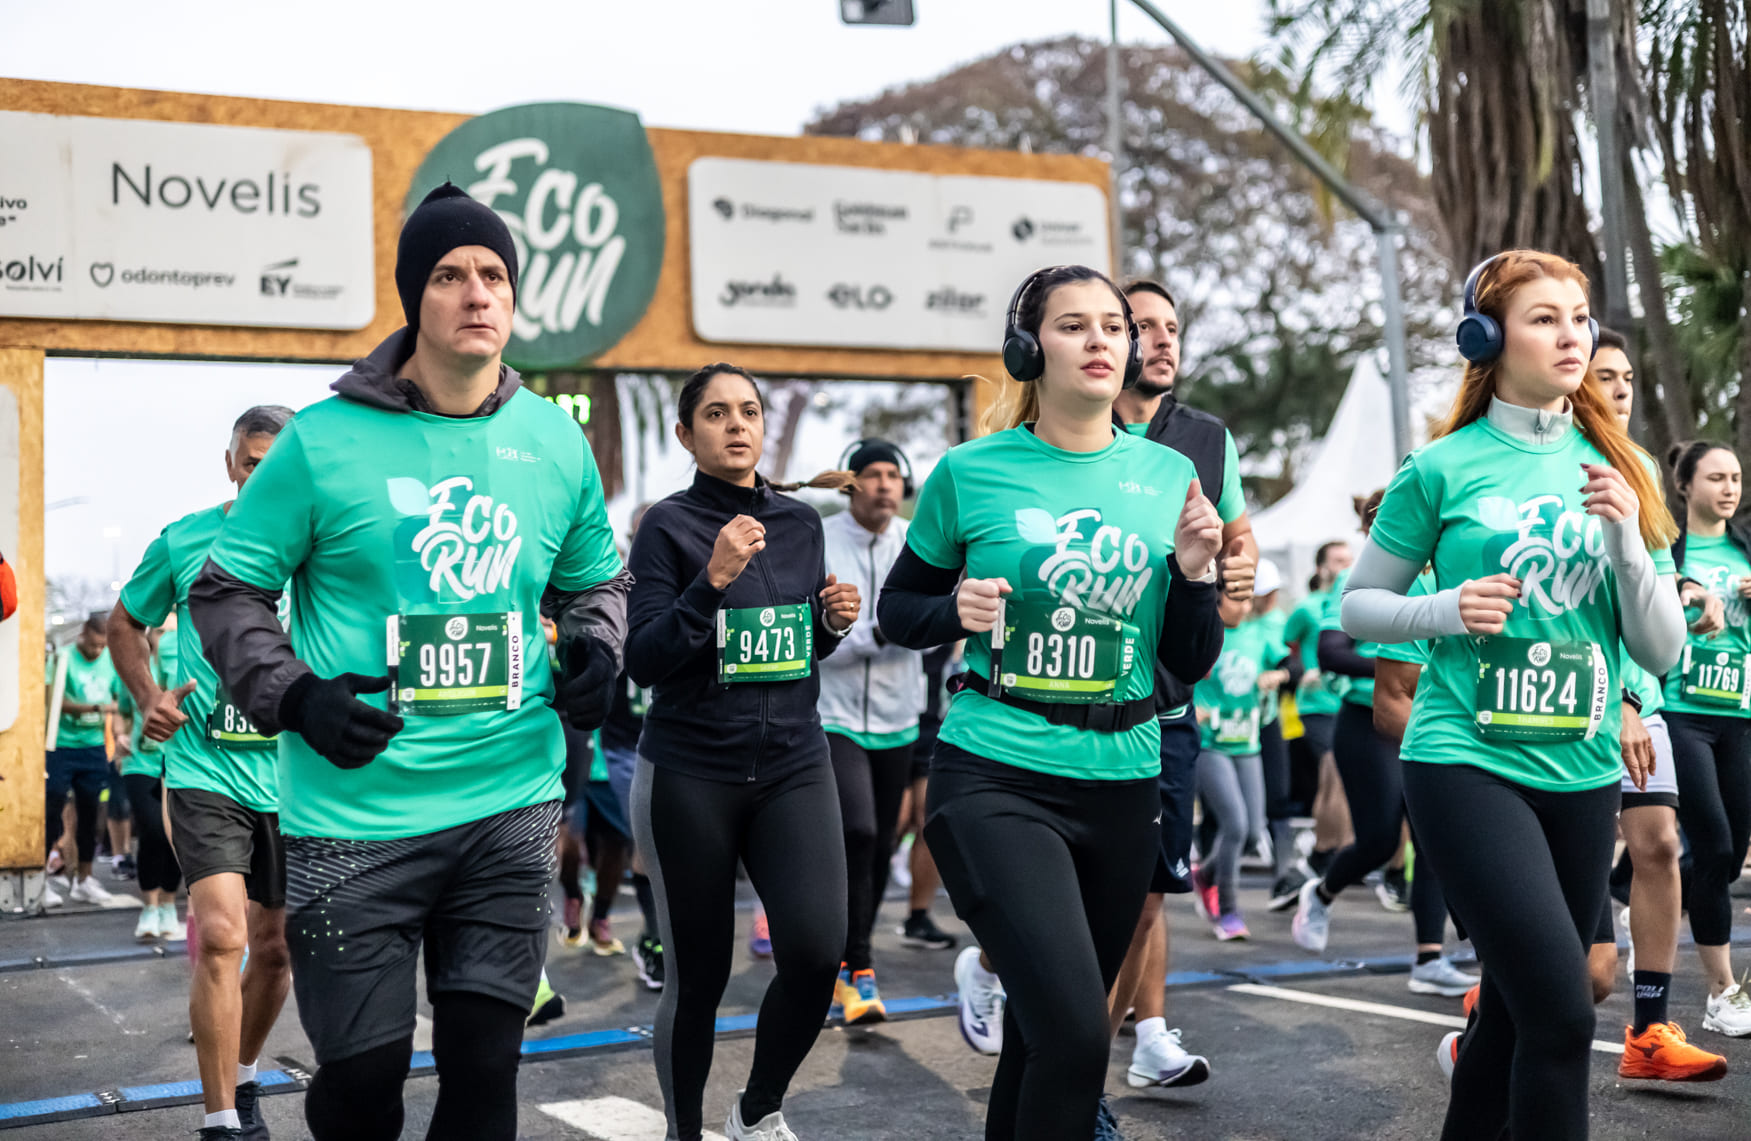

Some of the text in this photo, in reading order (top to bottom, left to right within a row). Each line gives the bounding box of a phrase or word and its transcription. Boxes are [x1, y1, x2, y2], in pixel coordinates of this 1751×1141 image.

[111, 161, 322, 219] Novelis
[468, 137, 619, 251] Eco
[120, 264, 236, 289] odontoprev
[259, 275, 292, 298] EY
[411, 476, 518, 553] Eco
[1500, 494, 1606, 568] Eco
[420, 532, 522, 600] Run
[1038, 508, 1149, 582] Eco
[1047, 560, 1153, 616] Run
[1510, 547, 1608, 616] Run
[739, 626, 796, 664] 9473
[1085, 617, 1110, 626] Novelis
[419, 642, 492, 687] 9957
[511, 634, 520, 688] BRANCO
[1026, 632, 1097, 679] 8310
[1121, 637, 1135, 677] VERDE
[1559, 652, 1583, 661] Novelis
[1698, 663, 1740, 693] 11769
[1495, 667, 1578, 714] 11624
[1593, 666, 1607, 721] BRANCO
